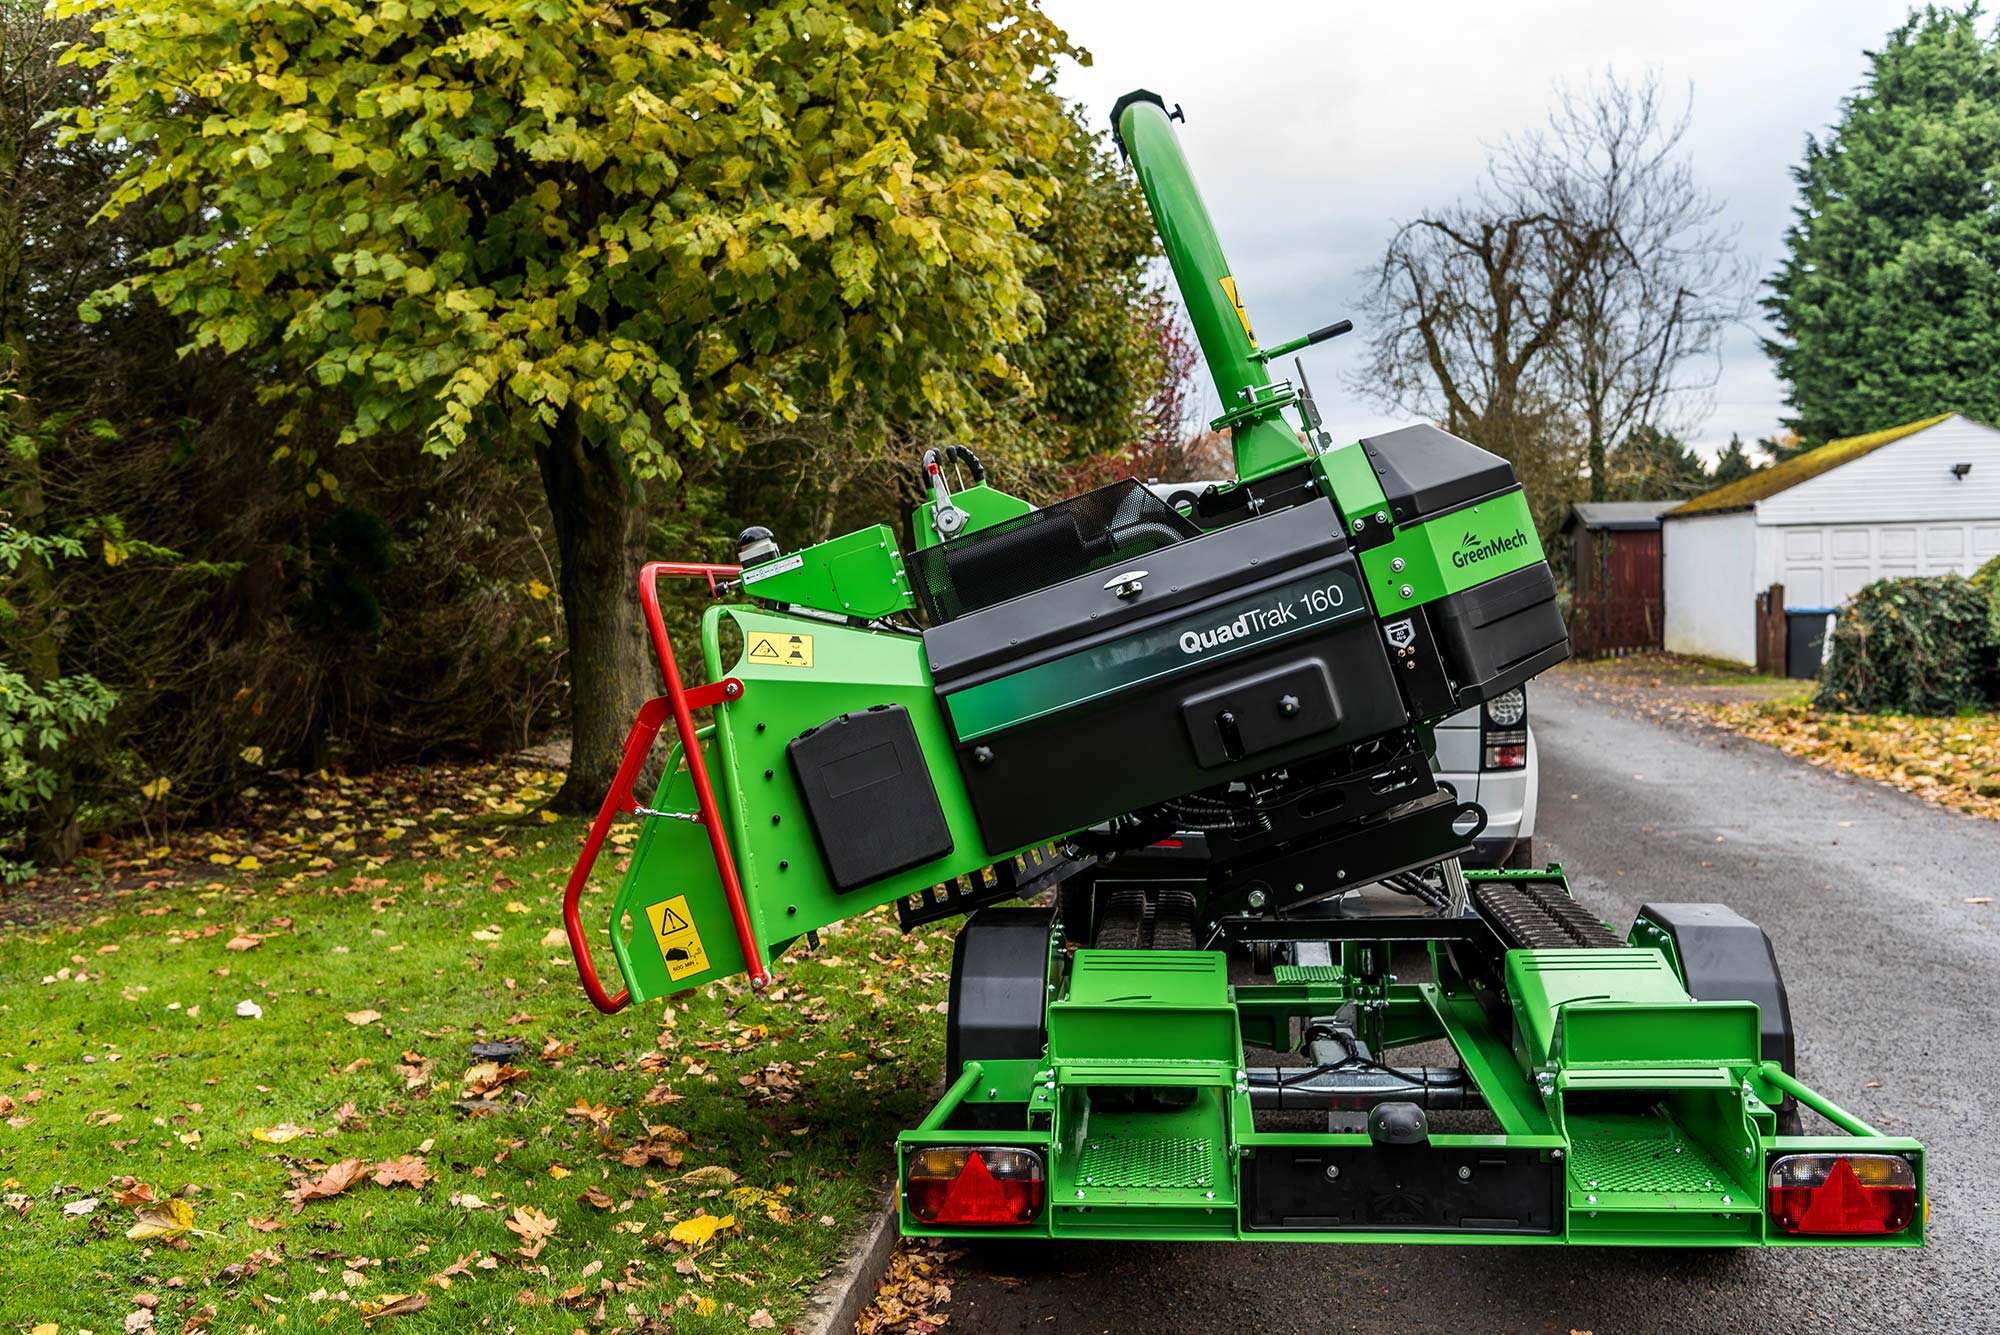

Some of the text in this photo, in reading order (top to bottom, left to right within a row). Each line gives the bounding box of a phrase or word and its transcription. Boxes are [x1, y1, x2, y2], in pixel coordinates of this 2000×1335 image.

[1452, 529, 1528, 568] GreenMech
[1179, 584, 1344, 653] QuadTrak 160
